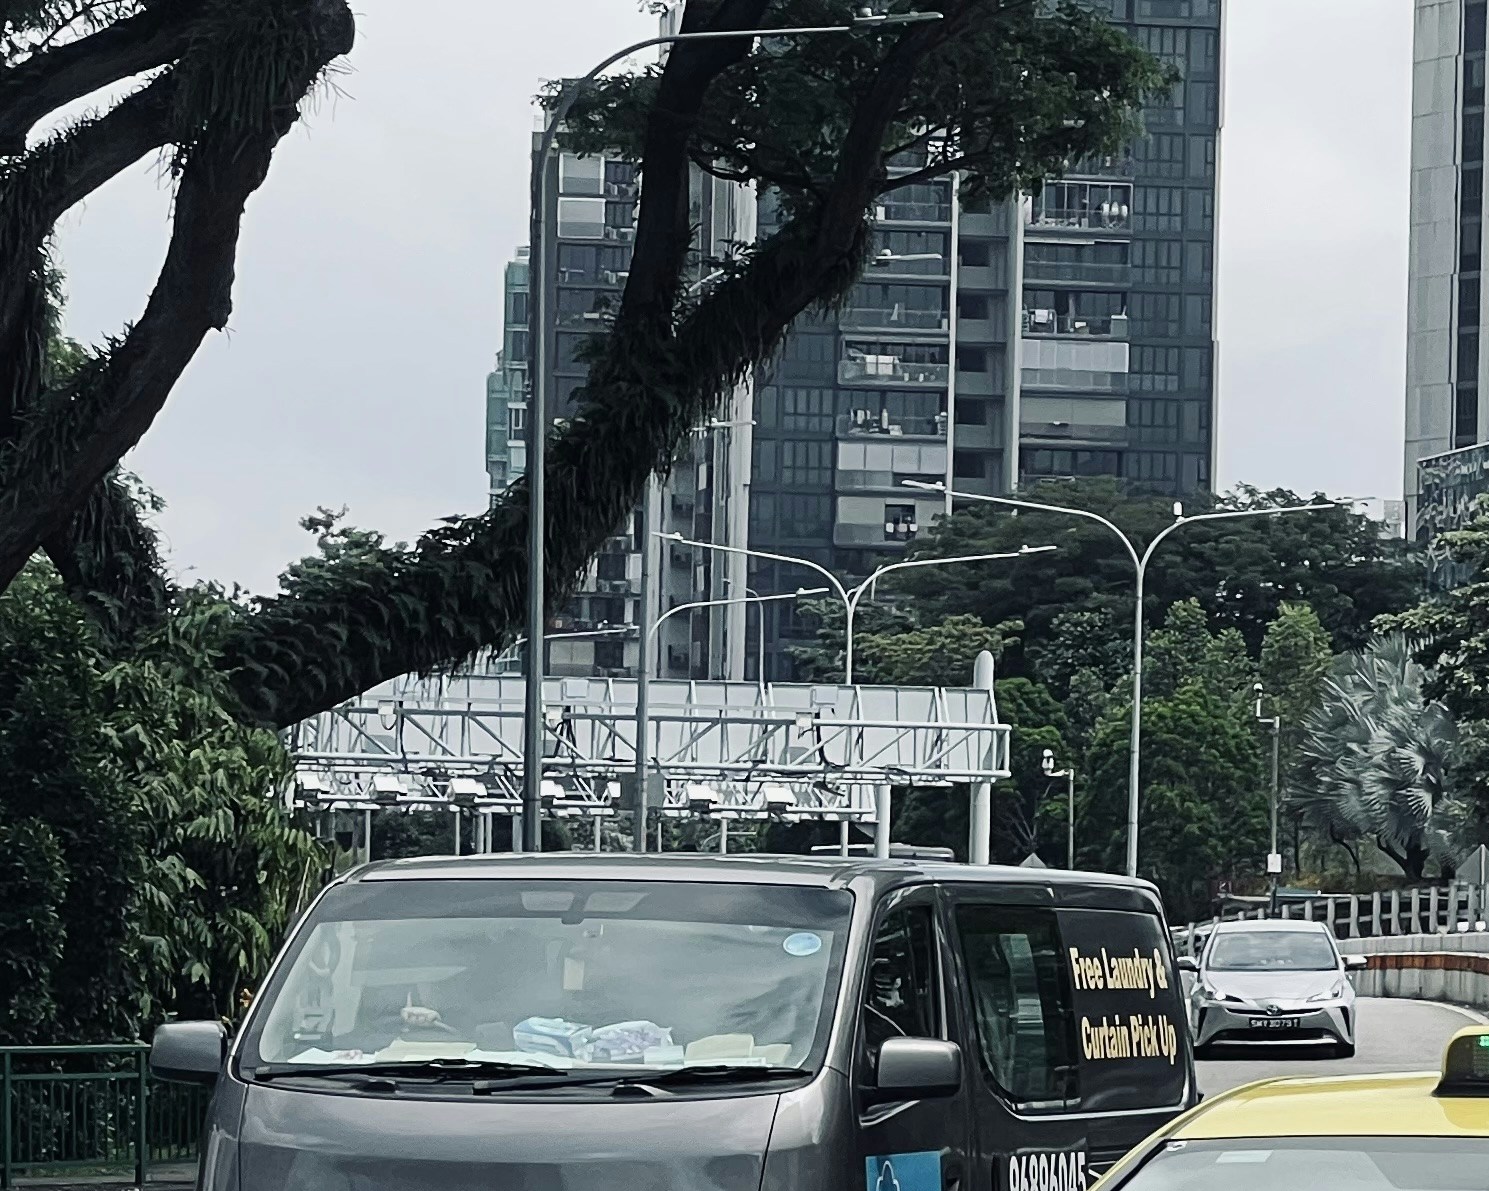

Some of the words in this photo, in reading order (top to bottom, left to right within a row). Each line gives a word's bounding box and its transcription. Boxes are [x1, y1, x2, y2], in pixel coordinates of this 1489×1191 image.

[1069, 947, 1104, 990] Free
[1101, 947, 1155, 999] Laundry
[1153, 947, 1168, 989] &
[1081, 1014, 1131, 1060] Curtain
[1129, 1013, 1160, 1058] Pick
[1158, 1014, 1177, 1066] Up
